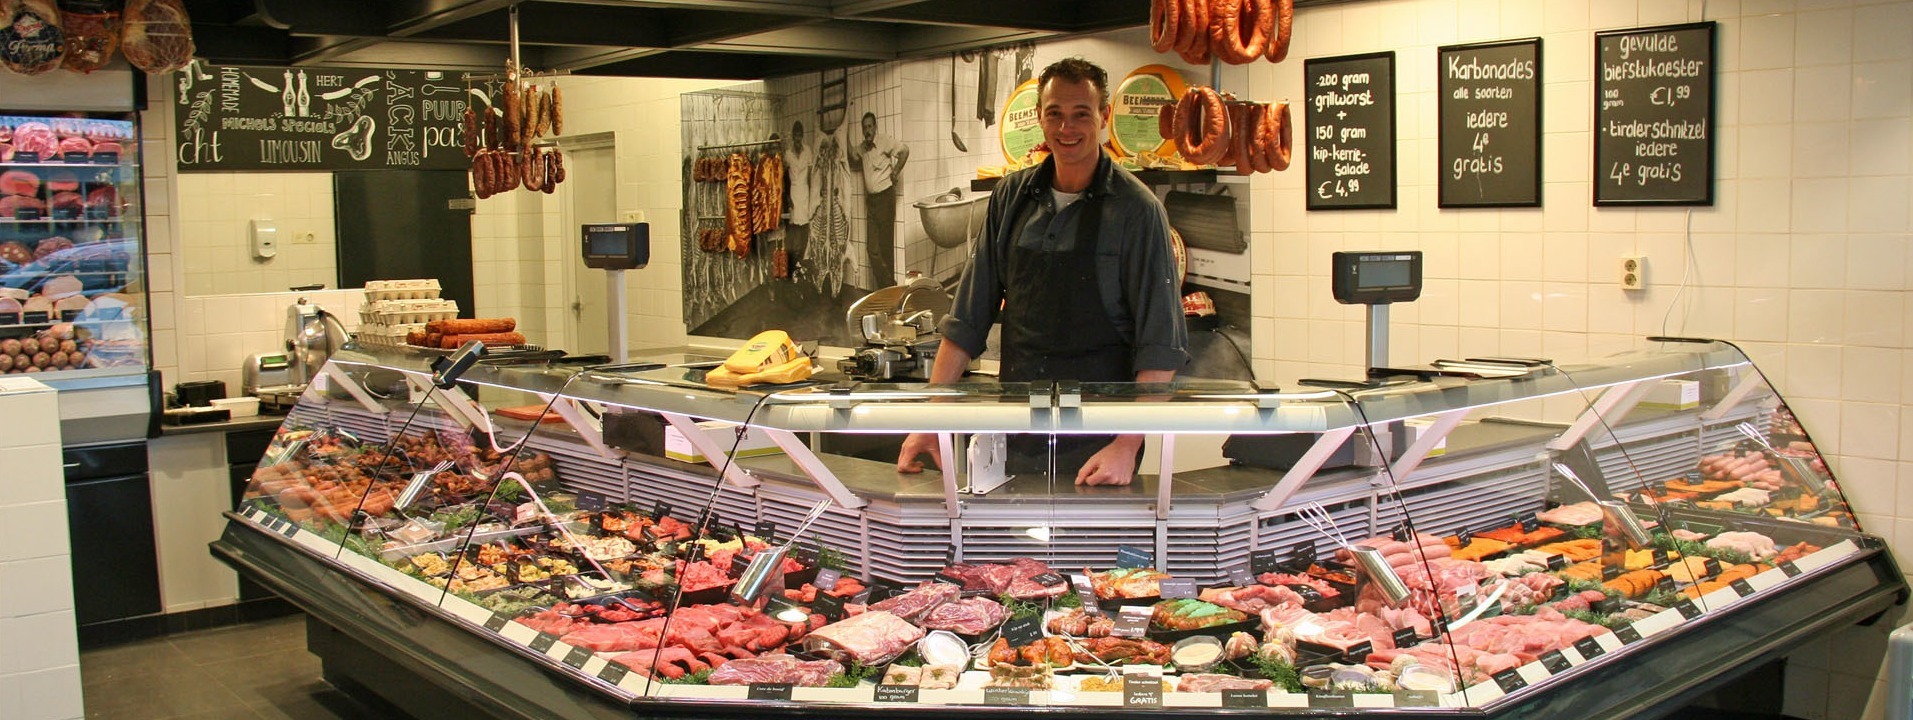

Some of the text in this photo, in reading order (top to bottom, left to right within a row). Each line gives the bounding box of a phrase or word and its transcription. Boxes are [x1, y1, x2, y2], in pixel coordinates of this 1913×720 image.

[1620, 33, 1678, 59] gevulde
[1448, 55, 1534, 80] Karbonades
[1603, 57, 1703, 82] biefstukoester
[221, 67, 240, 114] HOMEMADE
[316, 75, 344, 87] HERT
[1342, 73, 1370, 91] gram
[1315, 90, 1374, 112] grillworst
[1453, 86, 1513, 99] alle soorten
[1604, 89, 1619, 99] 100
[422, 100, 467, 121] PUUR
[1603, 99, 1624, 111] gram
[1466, 109, 1508, 129] iedere
[1315, 125, 1366, 143] 150 gram
[260, 139, 321, 164] LIMOUSIN
[386, 150, 420, 166] ANGUS
[1635, 141, 1678, 157] iedere
[1453, 155, 1503, 180] gratis
[1130, 696, 1158, 705] GRATIS
